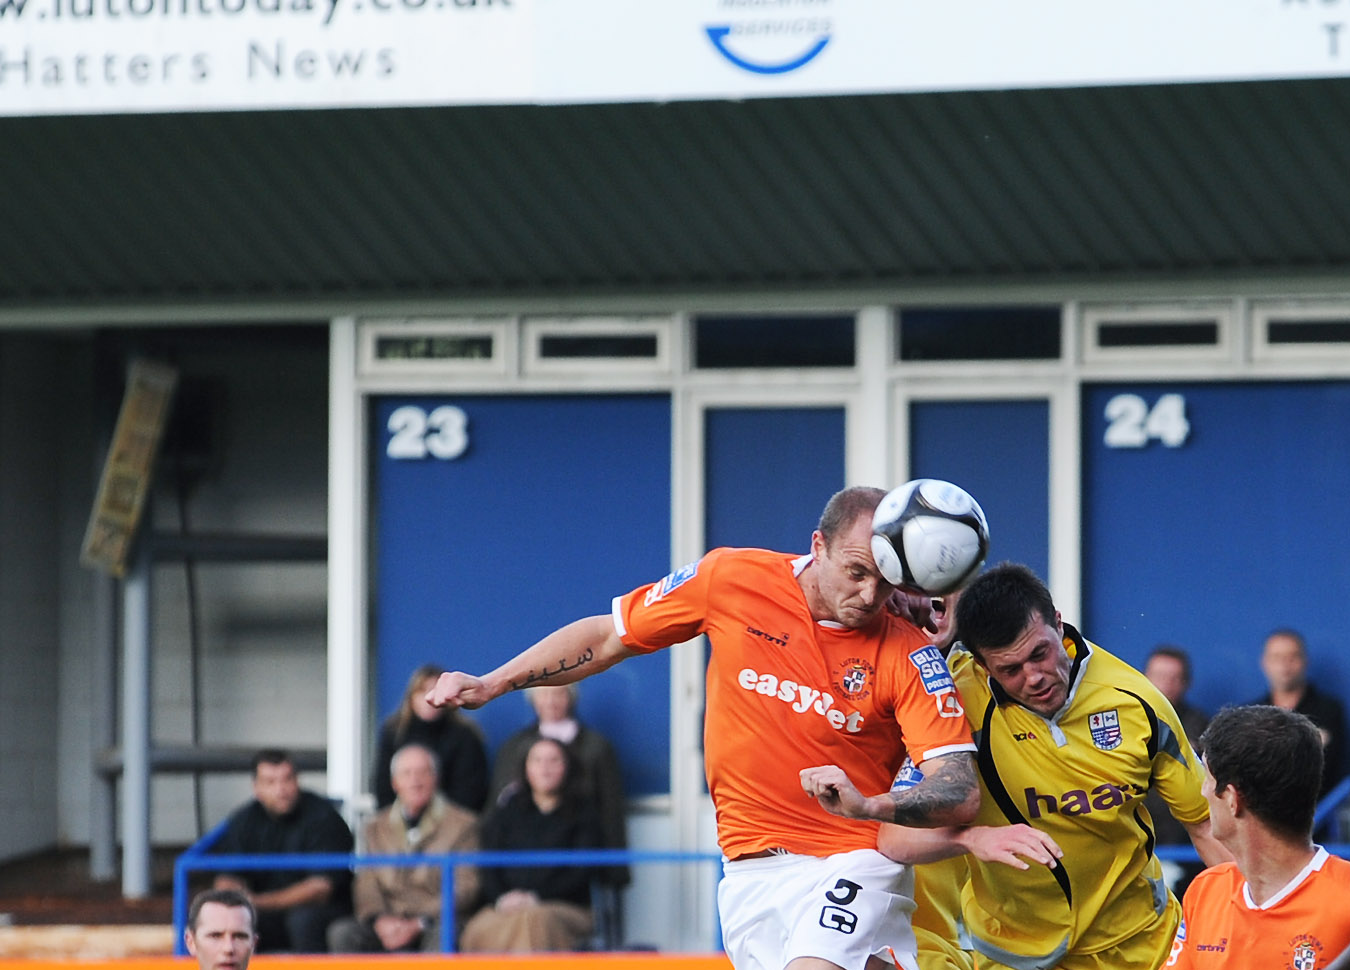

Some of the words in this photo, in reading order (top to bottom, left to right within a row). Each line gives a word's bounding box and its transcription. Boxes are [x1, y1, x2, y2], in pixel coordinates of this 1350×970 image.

[0, 43, 211, 87] Hatters
[246, 40, 398, 81] News
[387, 405, 469, 459] 23
[1103, 393, 1190, 448] 24
[921, 660, 945, 679] SQ
[738, 668, 865, 734] easyJet
[825, 878, 864, 906] 5
